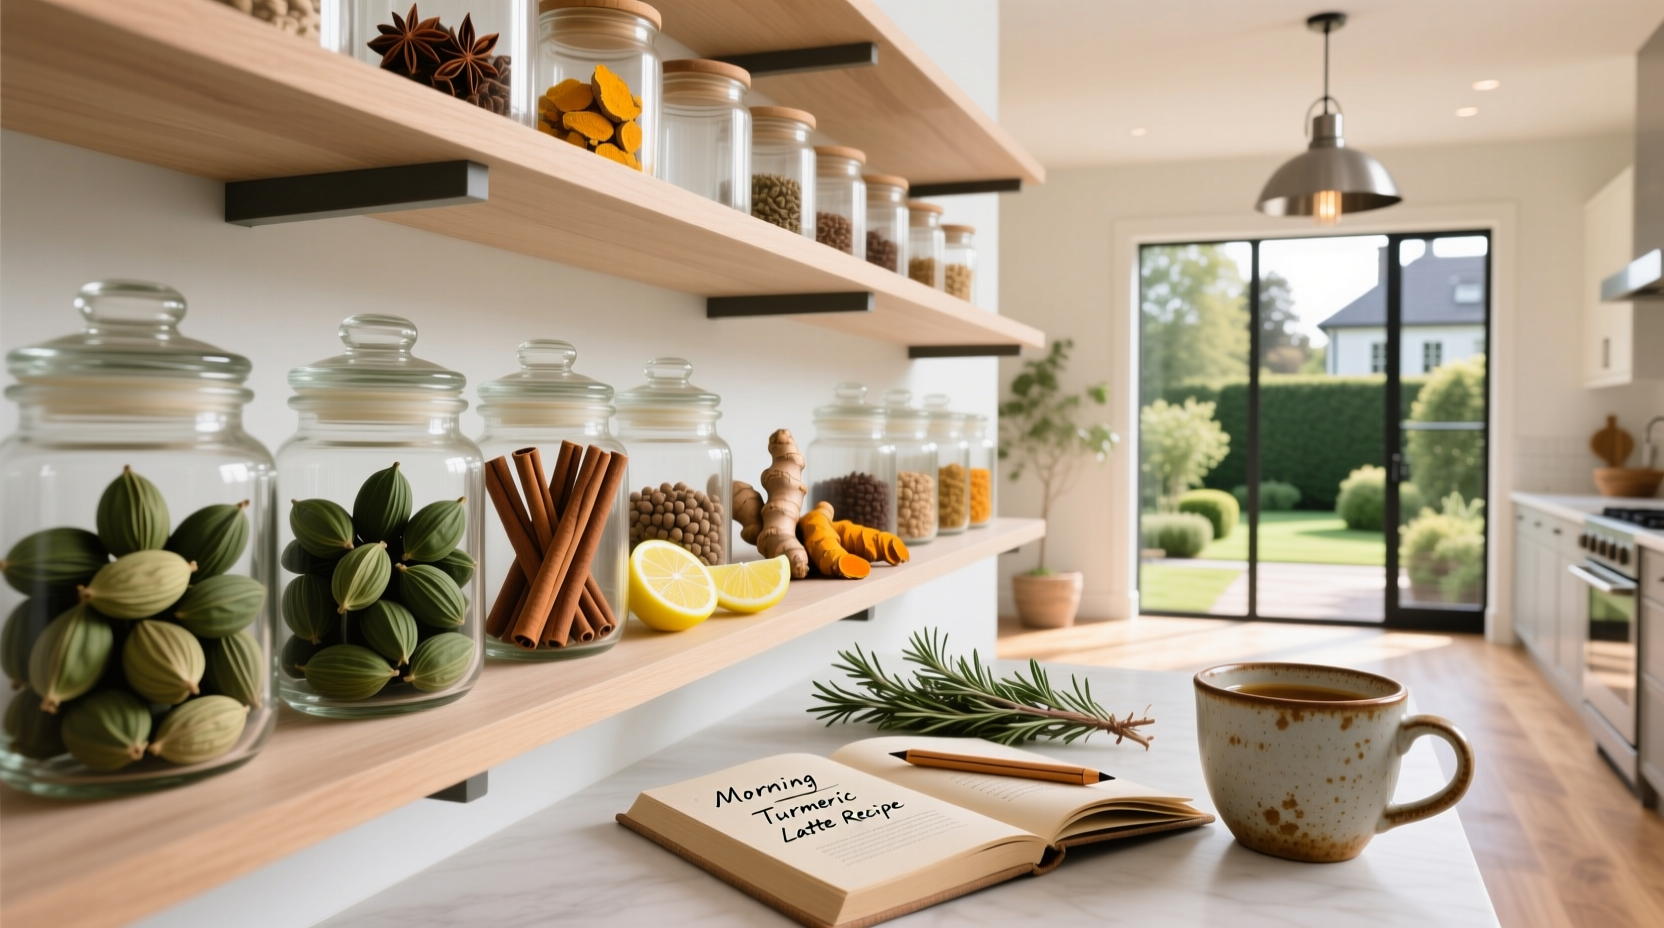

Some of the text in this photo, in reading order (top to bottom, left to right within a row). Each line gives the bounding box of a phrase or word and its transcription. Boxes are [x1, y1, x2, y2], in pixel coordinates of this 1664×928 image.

[715, 774, 818, 808] Morning
[751, 791, 857, 825] Turmeric
[781, 817, 837, 843] Latte
[841, 800, 905, 825] Recipe
